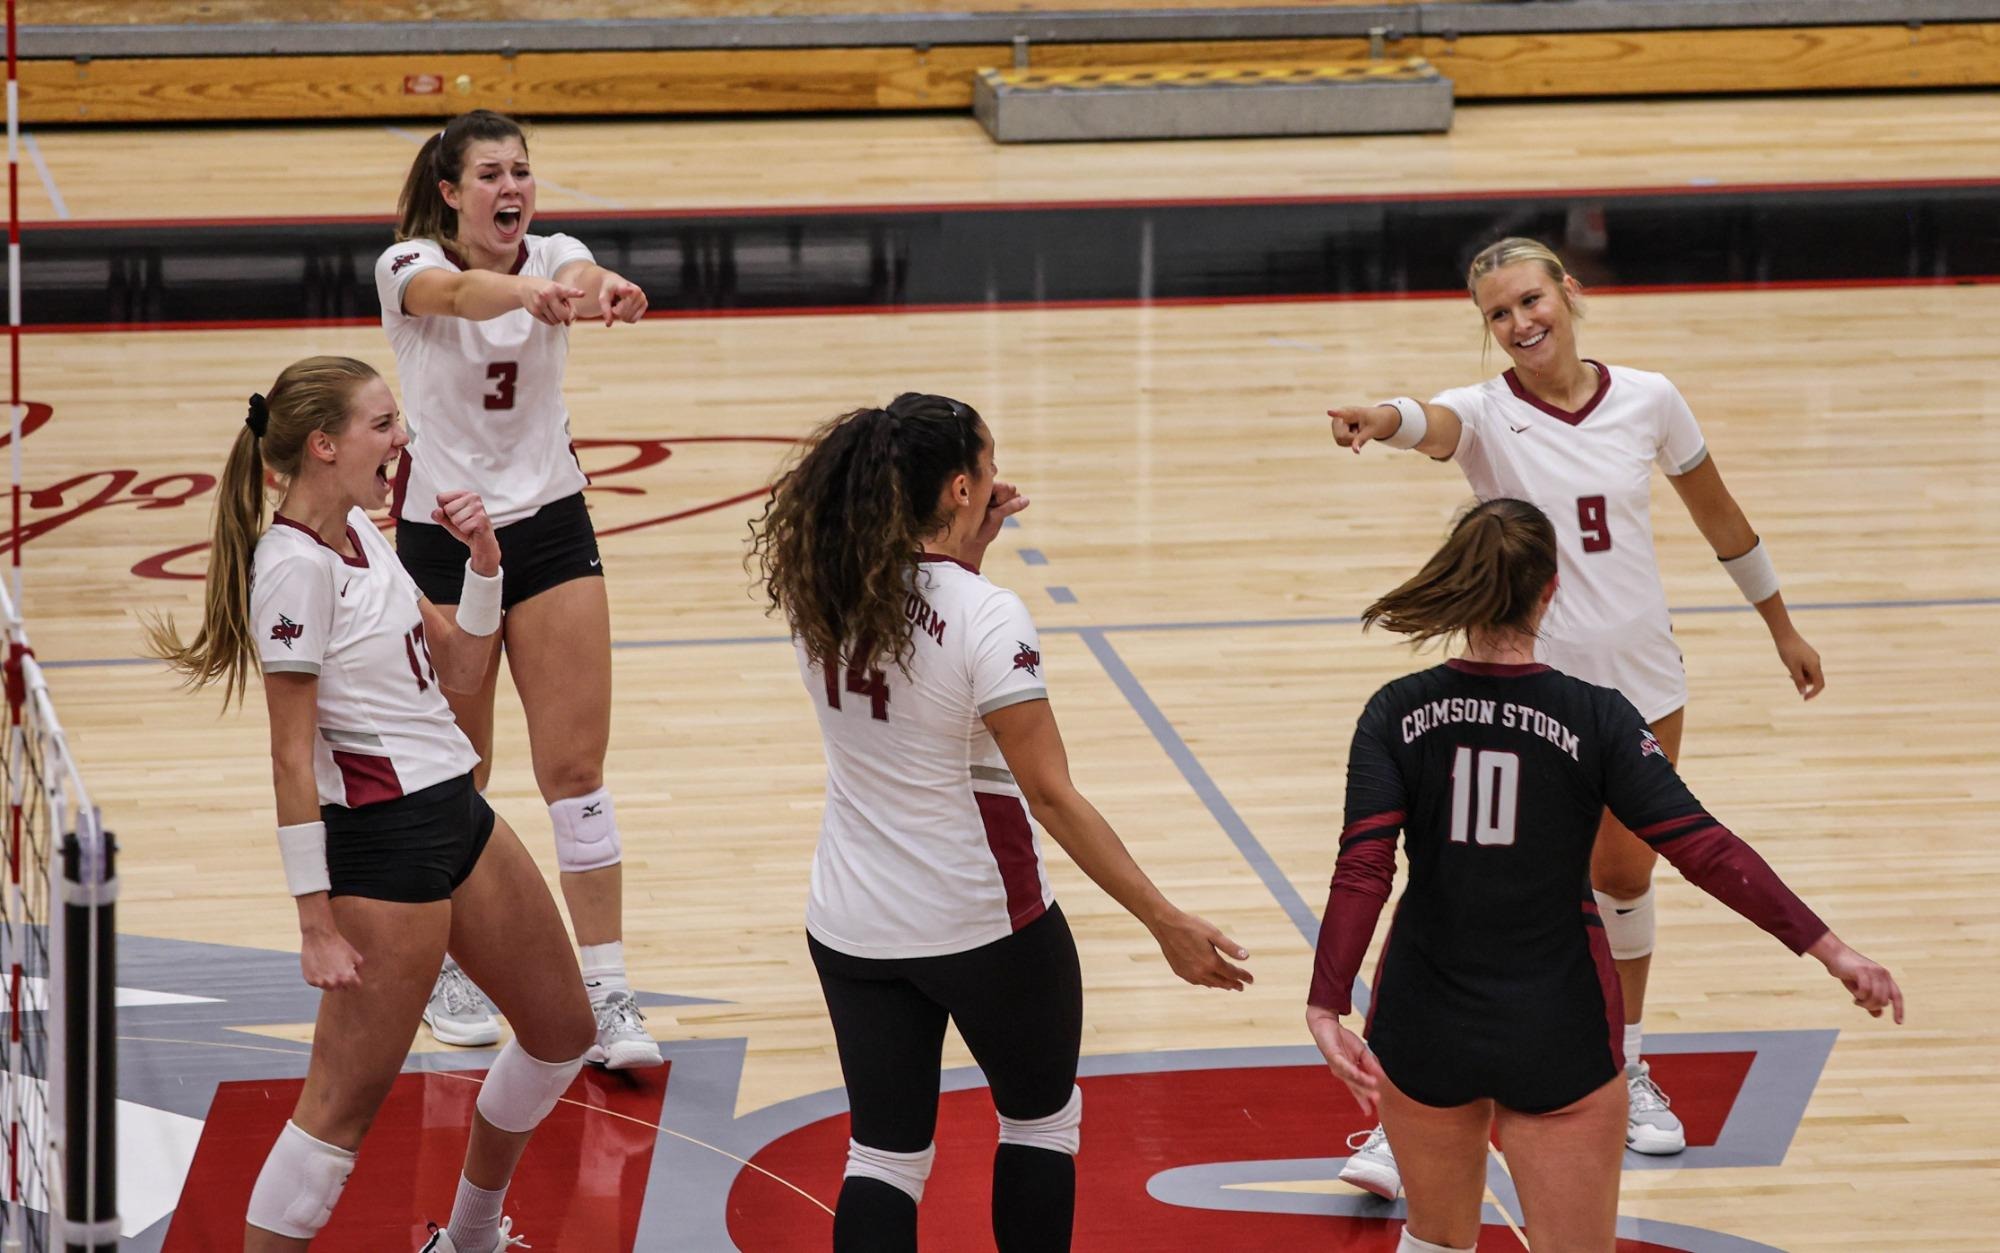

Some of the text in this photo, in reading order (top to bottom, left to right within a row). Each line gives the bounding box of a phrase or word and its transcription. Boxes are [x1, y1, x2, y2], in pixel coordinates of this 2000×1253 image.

[483, 361, 519, 411] 3
[1576, 494, 1611, 553] 9
[902, 591, 946, 647] ORM
[1401, 697, 1497, 744] CRIMSON
[1502, 702, 1580, 762] STORM
[1450, 745, 1520, 846] 10
